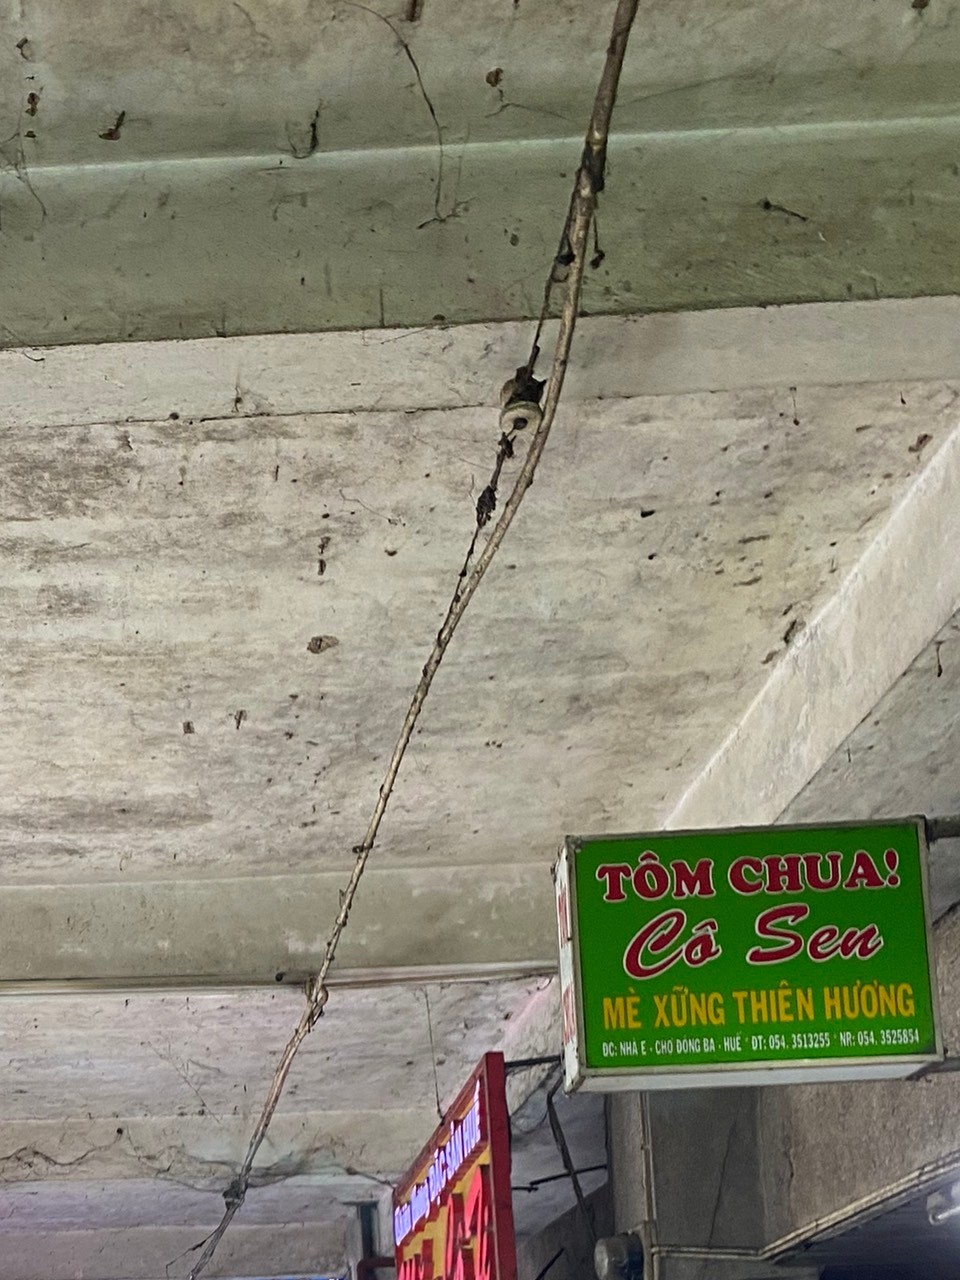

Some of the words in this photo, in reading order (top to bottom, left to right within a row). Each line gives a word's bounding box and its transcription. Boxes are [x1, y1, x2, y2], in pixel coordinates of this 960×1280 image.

[597, 851, 715, 902] TÔM
[728, 848, 901, 894] CHUA!
[623, 909, 722, 980] Cô
[746, 903, 884, 965] Sen
[603, 986, 642, 1030] MÈ
[732, 980, 815, 1023] THIÊN
[824, 981, 916, 1020] HƯƠNG
[703, 1037, 716, 1052] BA
